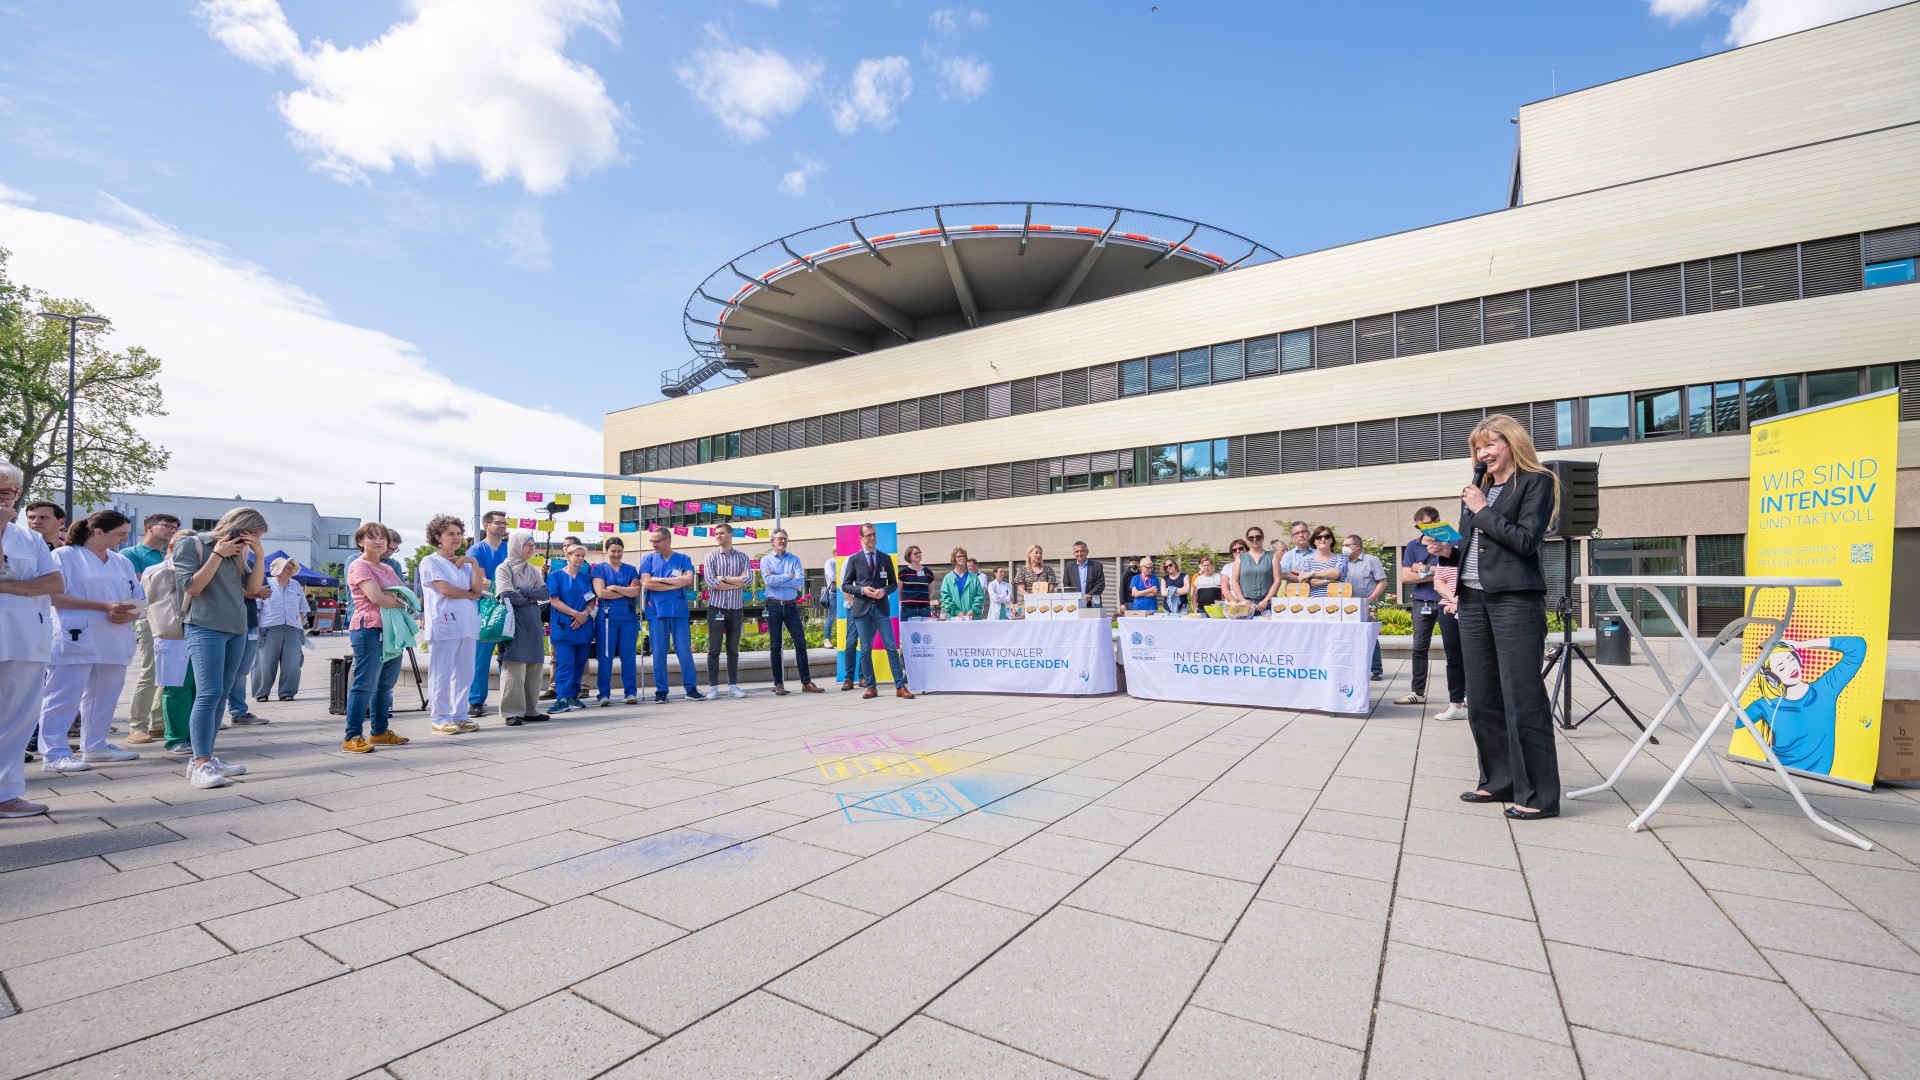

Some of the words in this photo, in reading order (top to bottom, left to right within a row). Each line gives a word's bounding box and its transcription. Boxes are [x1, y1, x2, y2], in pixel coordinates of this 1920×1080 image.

[1762, 469, 1805, 492] WIR
[1813, 458, 1878, 485] SIND
[1760, 482, 1877, 514] INTENSIV
[1759, 516, 1791, 530] UND
[1796, 508, 1876, 527] TAKTVOLL
[1757, 547, 1795, 557] UNSERE
[1797, 544, 1839, 555] SPOTIFY
[1795, 555, 1838, 567] PLAYLIST
[947, 648, 1043, 658] INTERNATIONALER
[1173, 651, 1294, 666] INTERNATIONALER
[949, 659, 970, 669] TAG
[973, 659, 993, 669] DER
[996, 659, 1069, 669] PFLEGENDEN
[1174, 663, 1199, 674] TAG
[1203, 665, 1230, 676] DER
[1234, 666, 1328, 681] PFLEGENDEN
